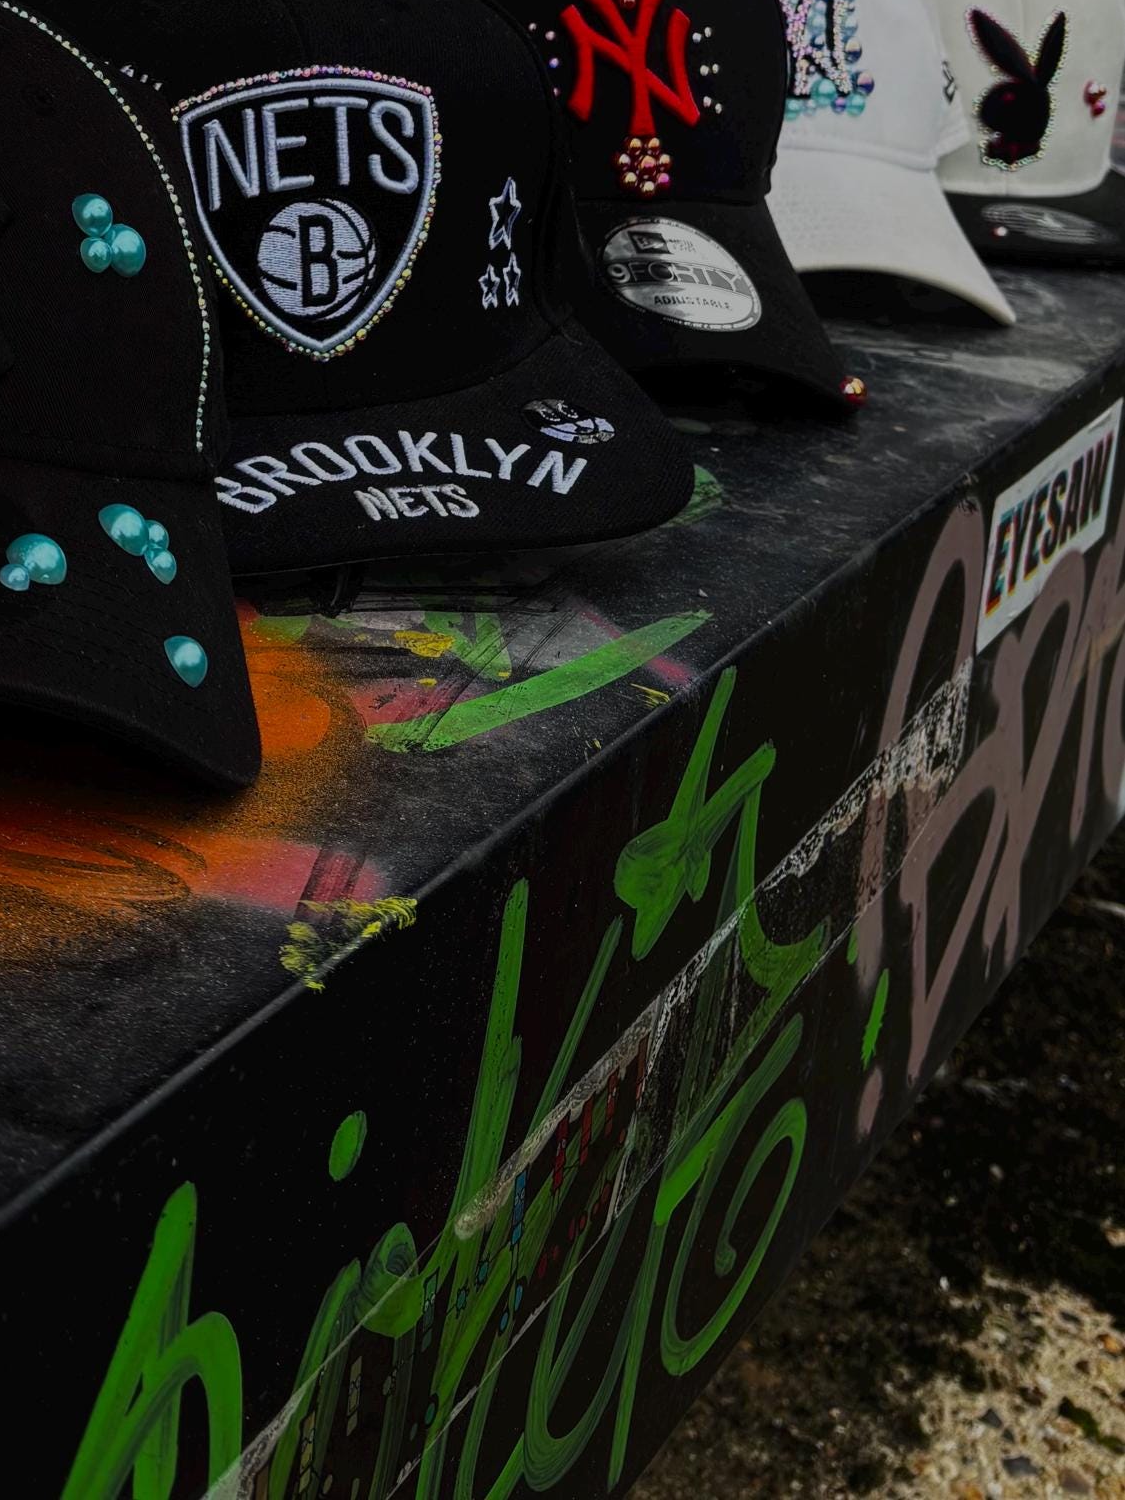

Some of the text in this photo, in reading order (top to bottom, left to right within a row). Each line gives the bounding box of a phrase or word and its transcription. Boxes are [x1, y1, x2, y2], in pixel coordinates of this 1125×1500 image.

[202, 97, 419, 212] NETS
[298, 214, 338, 307] B
[214, 430, 588, 514] BROOKLYN
[353, 483, 480, 521] NETS
[985, 430, 1114, 617] EYESAW
